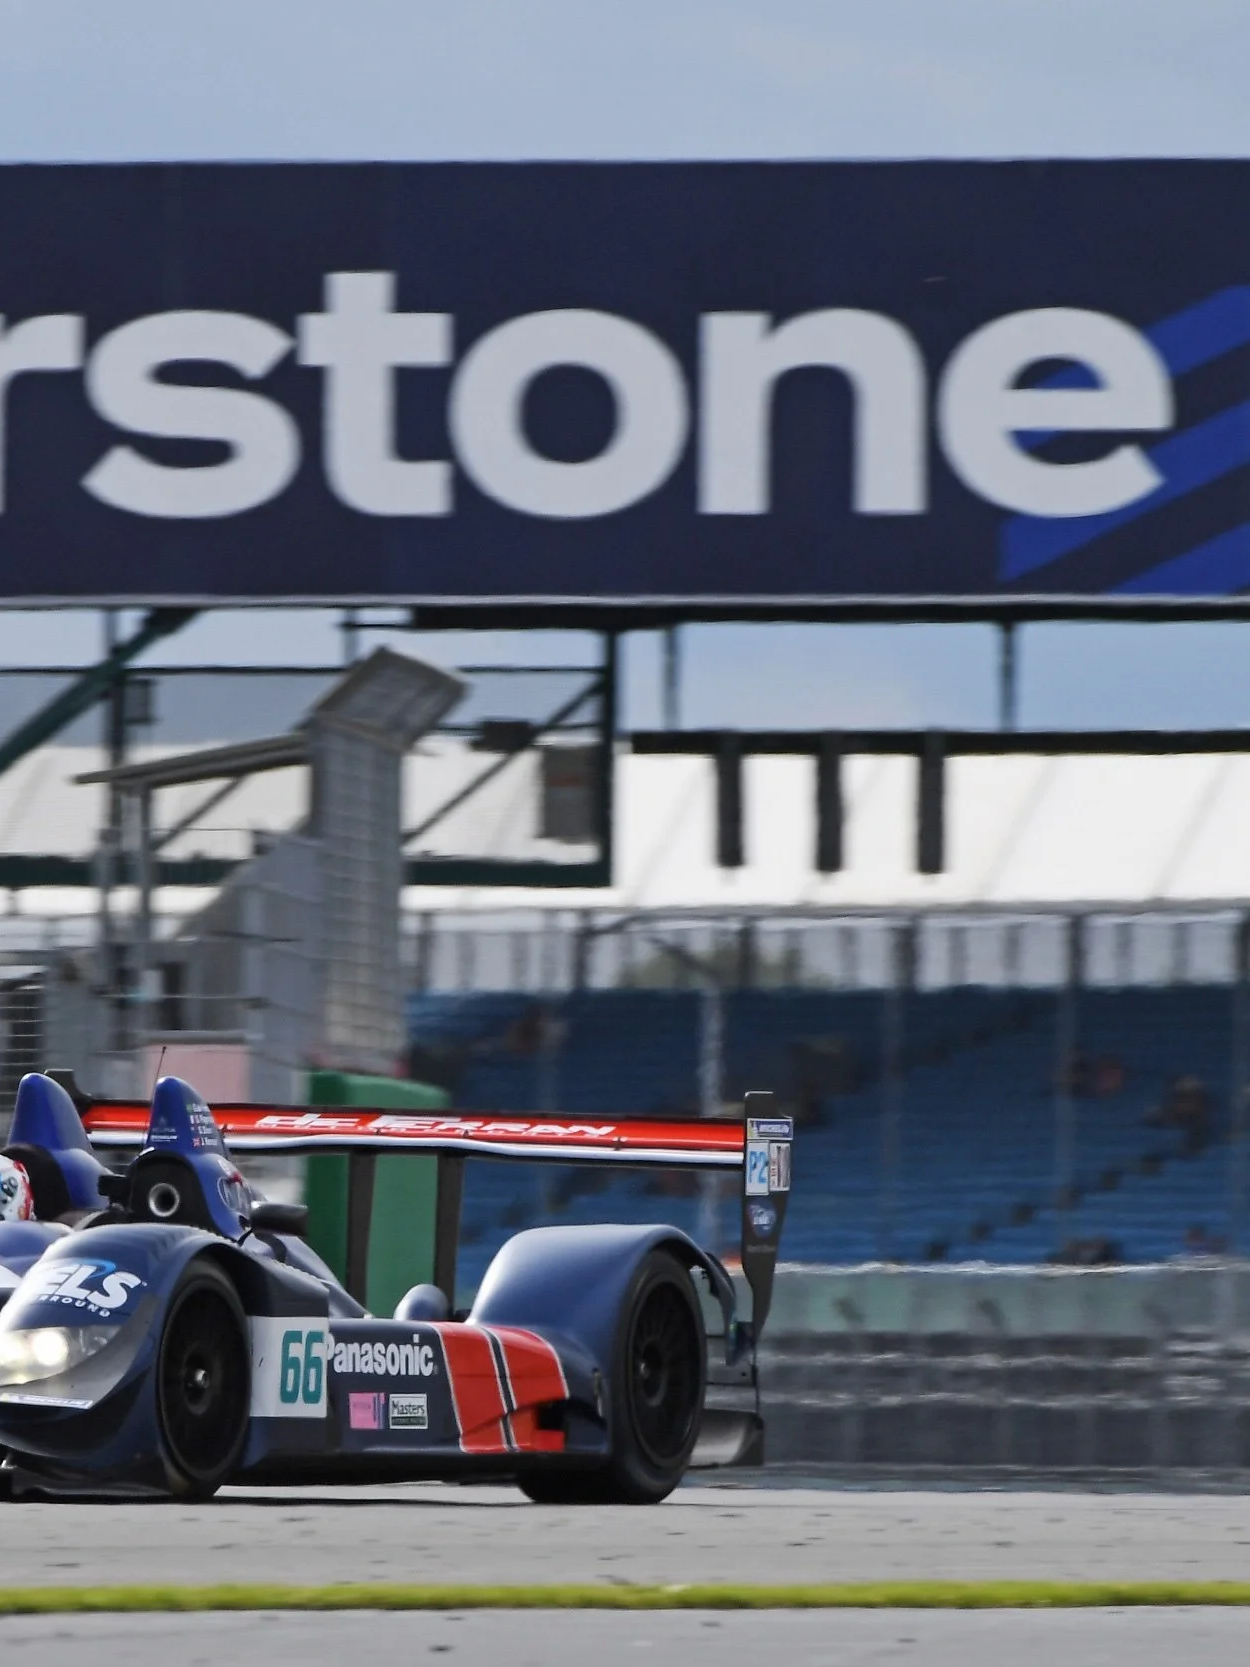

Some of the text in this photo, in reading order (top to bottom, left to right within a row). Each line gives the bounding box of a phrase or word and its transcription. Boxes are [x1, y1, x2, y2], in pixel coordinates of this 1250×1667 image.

[749, 1151, 768, 1184] P2
[280, 1330, 325, 1404] 66
[326, 1333, 434, 1376] Panasonic
[392, 1400, 425, 1416] Masters
